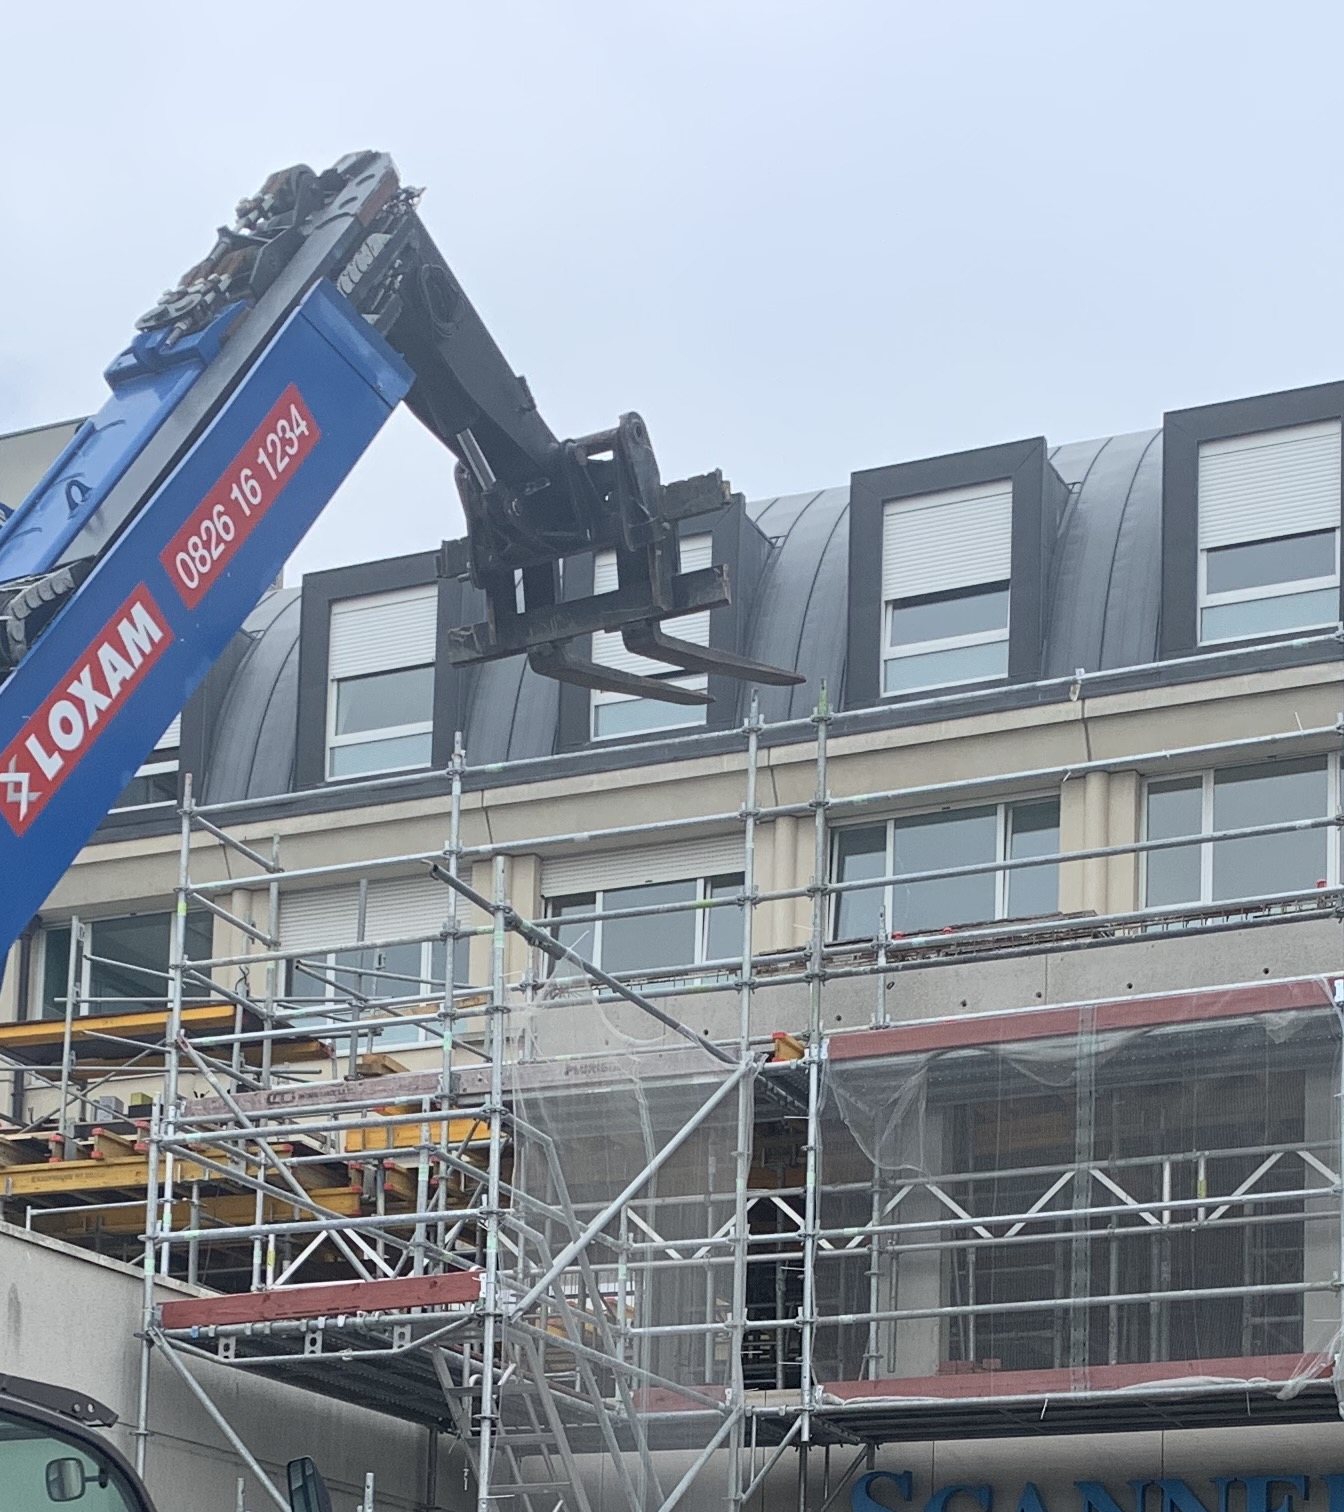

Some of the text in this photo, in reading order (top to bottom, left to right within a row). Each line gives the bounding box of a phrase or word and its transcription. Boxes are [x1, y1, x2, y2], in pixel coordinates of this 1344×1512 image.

[174, 402, 309, 589] 0826 16 1234
[23, 600, 165, 781] LOXAM
